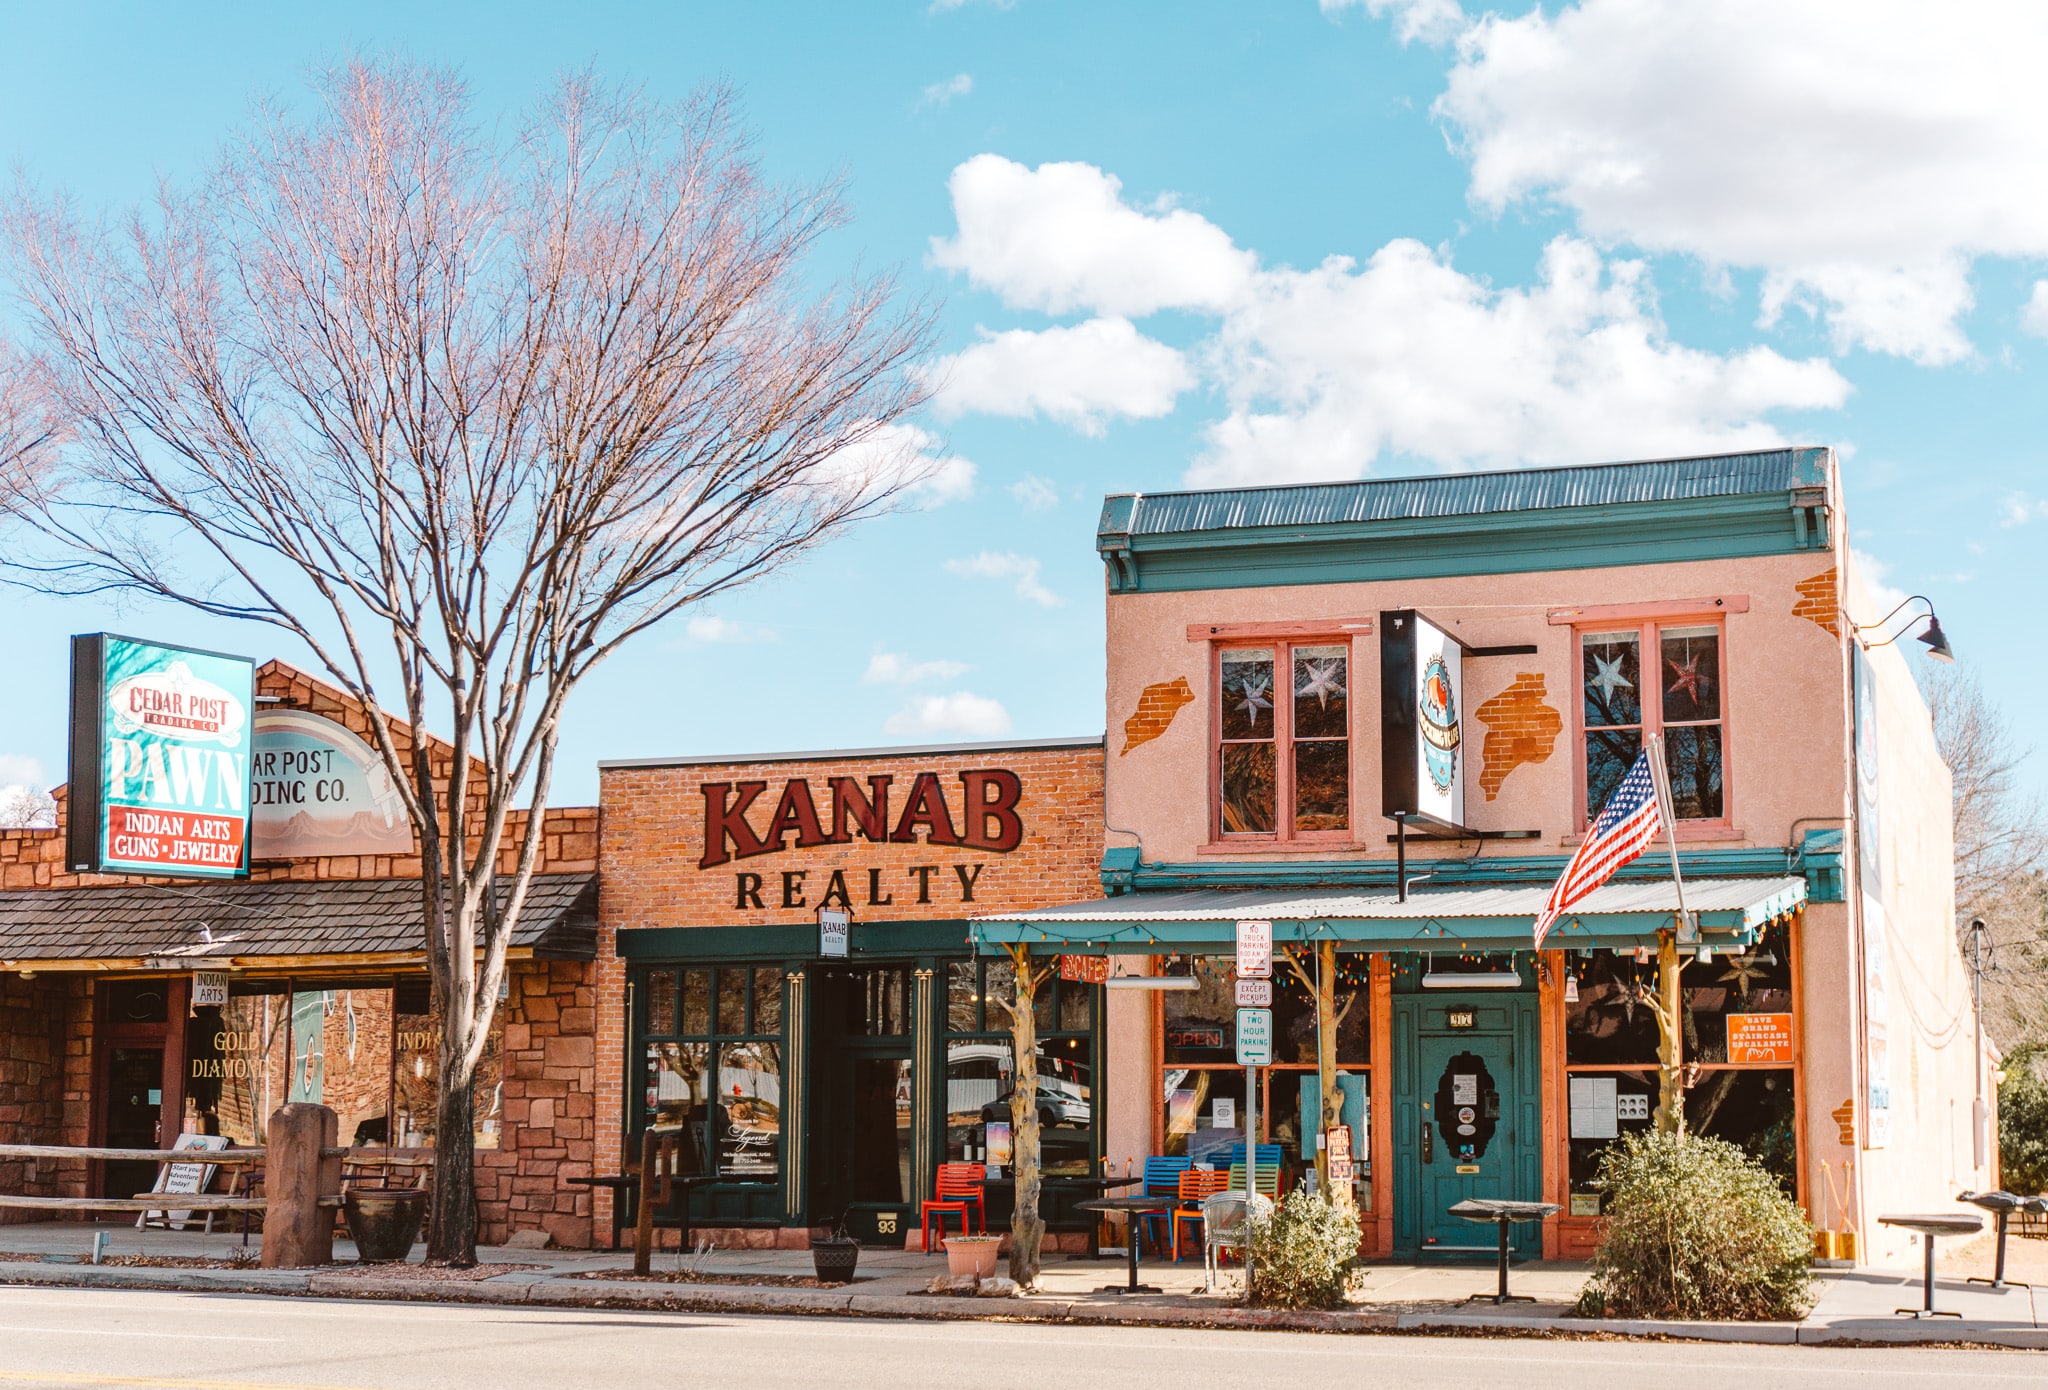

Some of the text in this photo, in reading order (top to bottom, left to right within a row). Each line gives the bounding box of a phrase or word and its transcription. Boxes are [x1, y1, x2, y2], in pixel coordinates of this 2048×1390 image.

[130, 687, 229, 725] CEDAR POST
[146, 713, 218, 732] TRADING CO.
[283, 750, 335, 775] POST
[109, 738, 245, 810] PAWN
[252, 779, 349, 805] DING CO.
[125, 813, 230, 840] INDIAN ARTS
[699, 769, 1022, 869] KANAB
[114, 836, 238, 864] GUNS JEWELRY
[735, 864, 984, 909] REALTY
[822, 921, 846, 936] KANAB
[825, 936, 843, 944] REALTY
[1244, 934, 1265, 942] TRUCK
[197, 973, 226, 987] INDIAN
[200, 989, 223, 1001] ARTS
[1241, 985, 1266, 993] EXCEPT
[1247, 1016, 1263, 1024] TWO
[214, 1031, 260, 1050] GOLD
[397, 1031, 443, 1050] INDIA
[1240, 1038, 1268, 1047] PARKING
[192, 1058, 280, 1078] DIAMONDS
[1332, 1146, 1347, 1154] ONLY
[170, 1172, 199, 1180] Adventure
[170, 1180, 190, 1188] today!
[878, 1221, 896, 1233] 93
